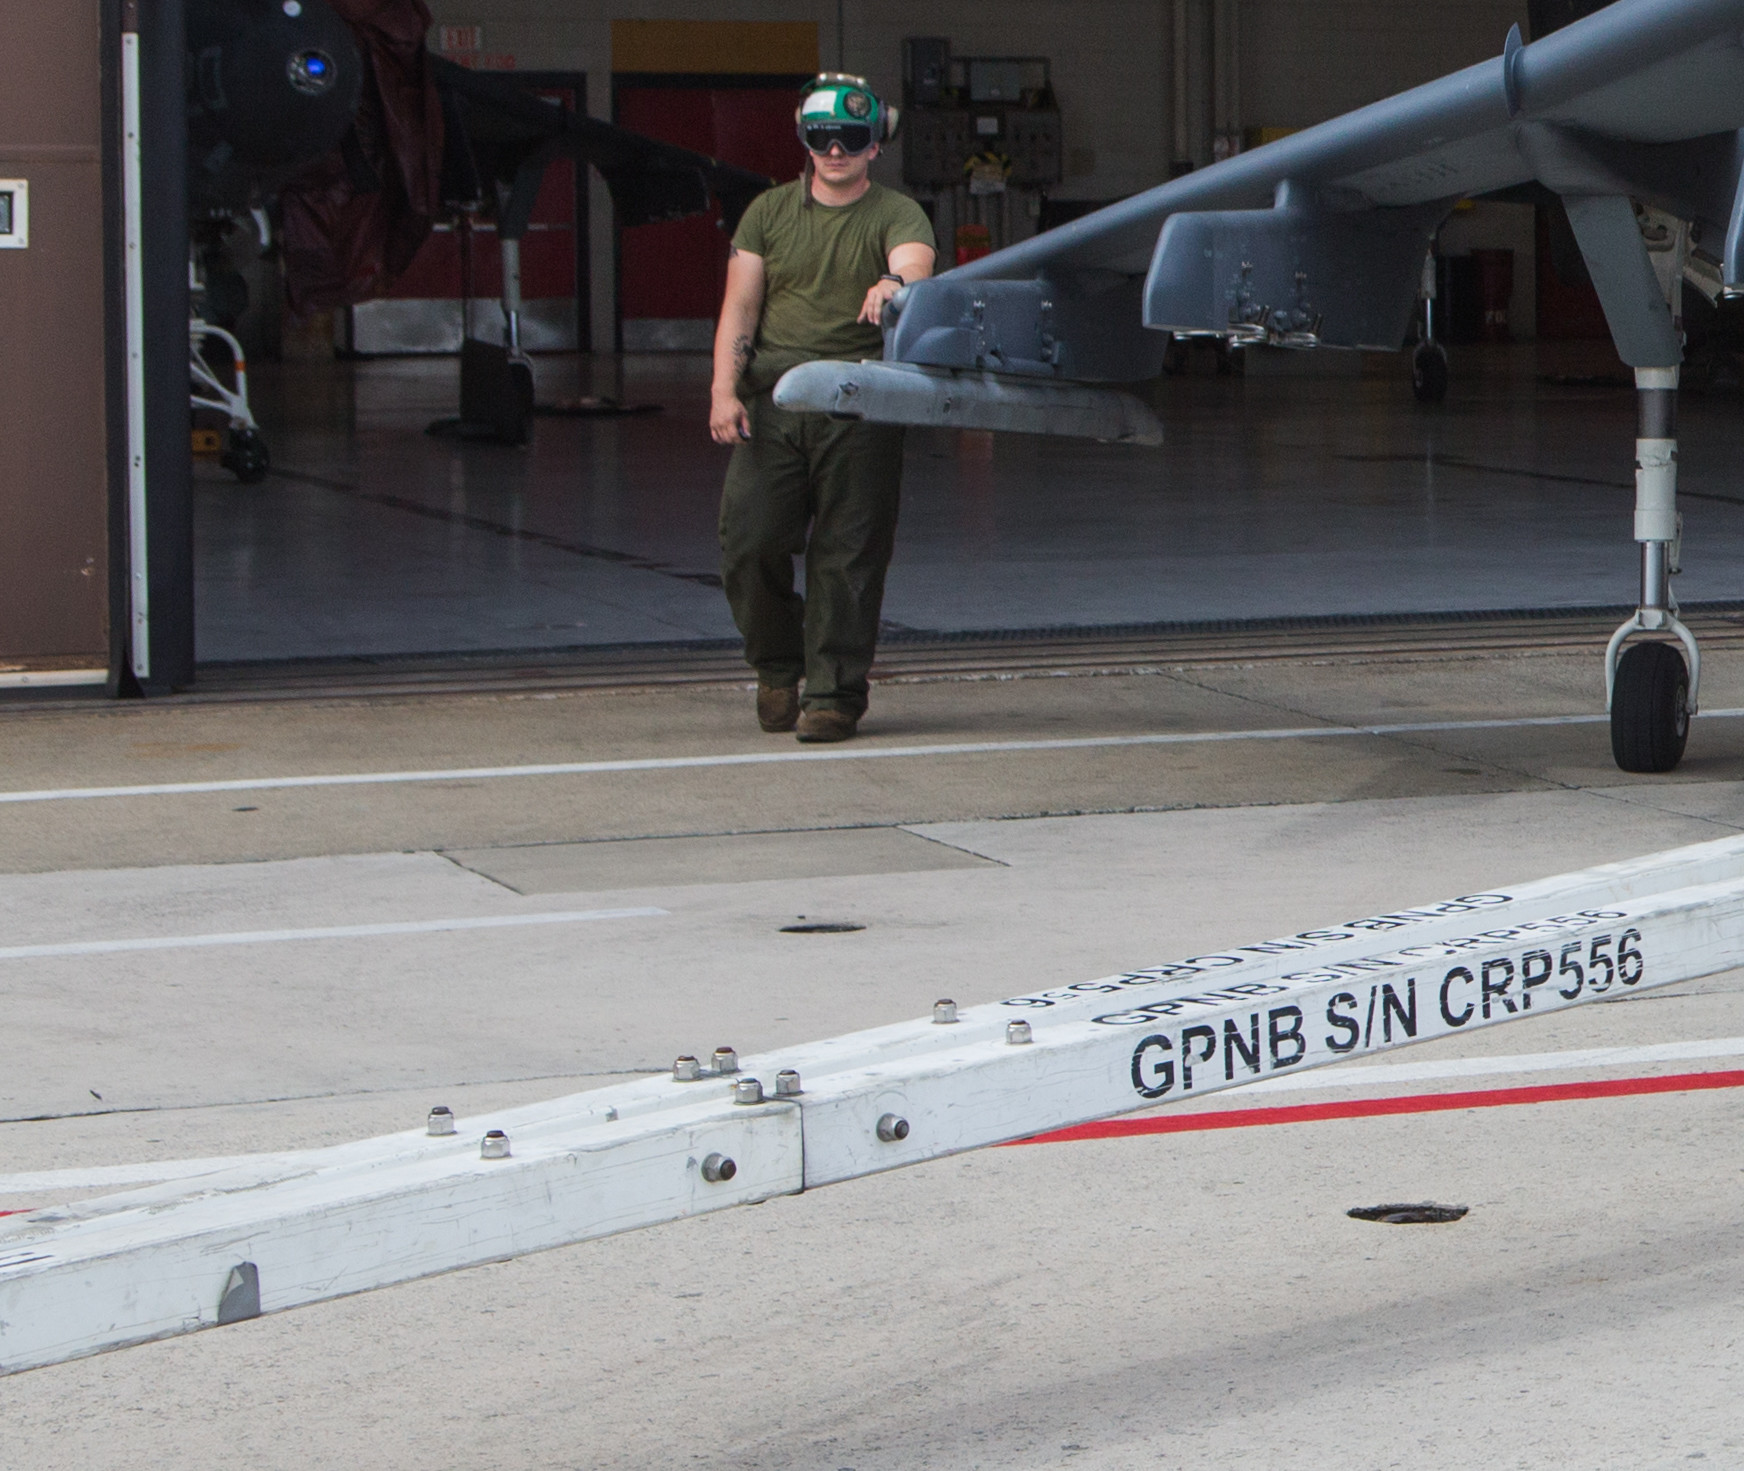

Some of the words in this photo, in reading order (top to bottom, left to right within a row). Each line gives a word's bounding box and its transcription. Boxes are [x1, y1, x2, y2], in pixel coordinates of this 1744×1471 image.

[1343, 893, 1514, 931] GPNB
[1091, 983, 1289, 1026] GPNB
[1281, 958, 1404, 983] S/N
[1398, 909, 1628, 956] CRP556
[1237, 930, 1354, 954] S/N
[1000, 955, 1244, 1008] CRP556
[1131, 1005, 1307, 1099] GPNB
[1325, 978, 1418, 1054] S/N
[1440, 928, 1643, 1027] CRP556
